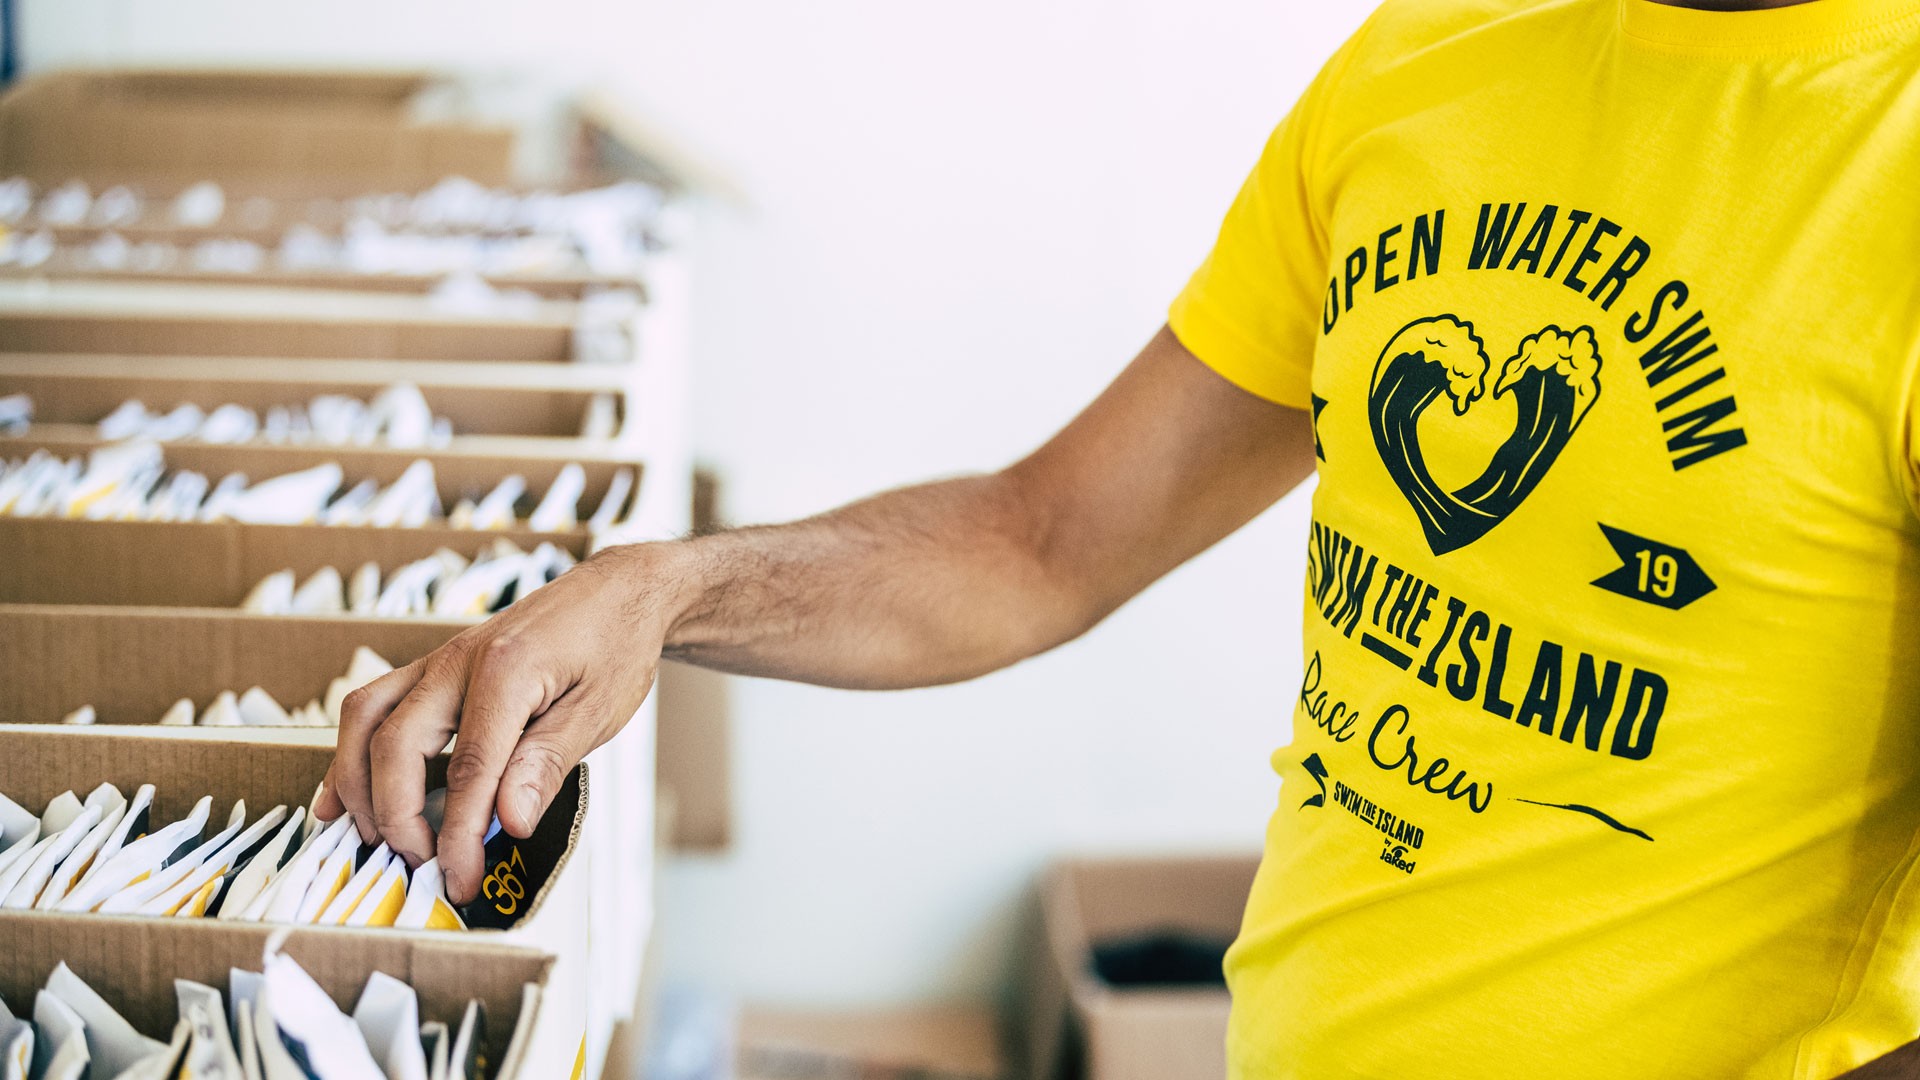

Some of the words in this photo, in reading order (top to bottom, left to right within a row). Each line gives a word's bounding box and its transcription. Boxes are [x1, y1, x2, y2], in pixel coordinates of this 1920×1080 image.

[1323, 209, 1446, 336] OPEN
[1467, 202, 1652, 312] WATER
[1624, 279, 1748, 472] SWIM
[1308, 516, 1379, 640] SWIM
[1372, 563, 1440, 648] THE
[1417, 596, 1669, 761] ISLAND
[1634, 548, 1679, 599] 19
[1301, 650, 1360, 743] Race
[1367, 704, 1493, 814] Crew
[1333, 780, 1363, 817] SWIM
[1362, 799, 1377, 820] THE
[1375, 807, 1425, 850] ISLAND
